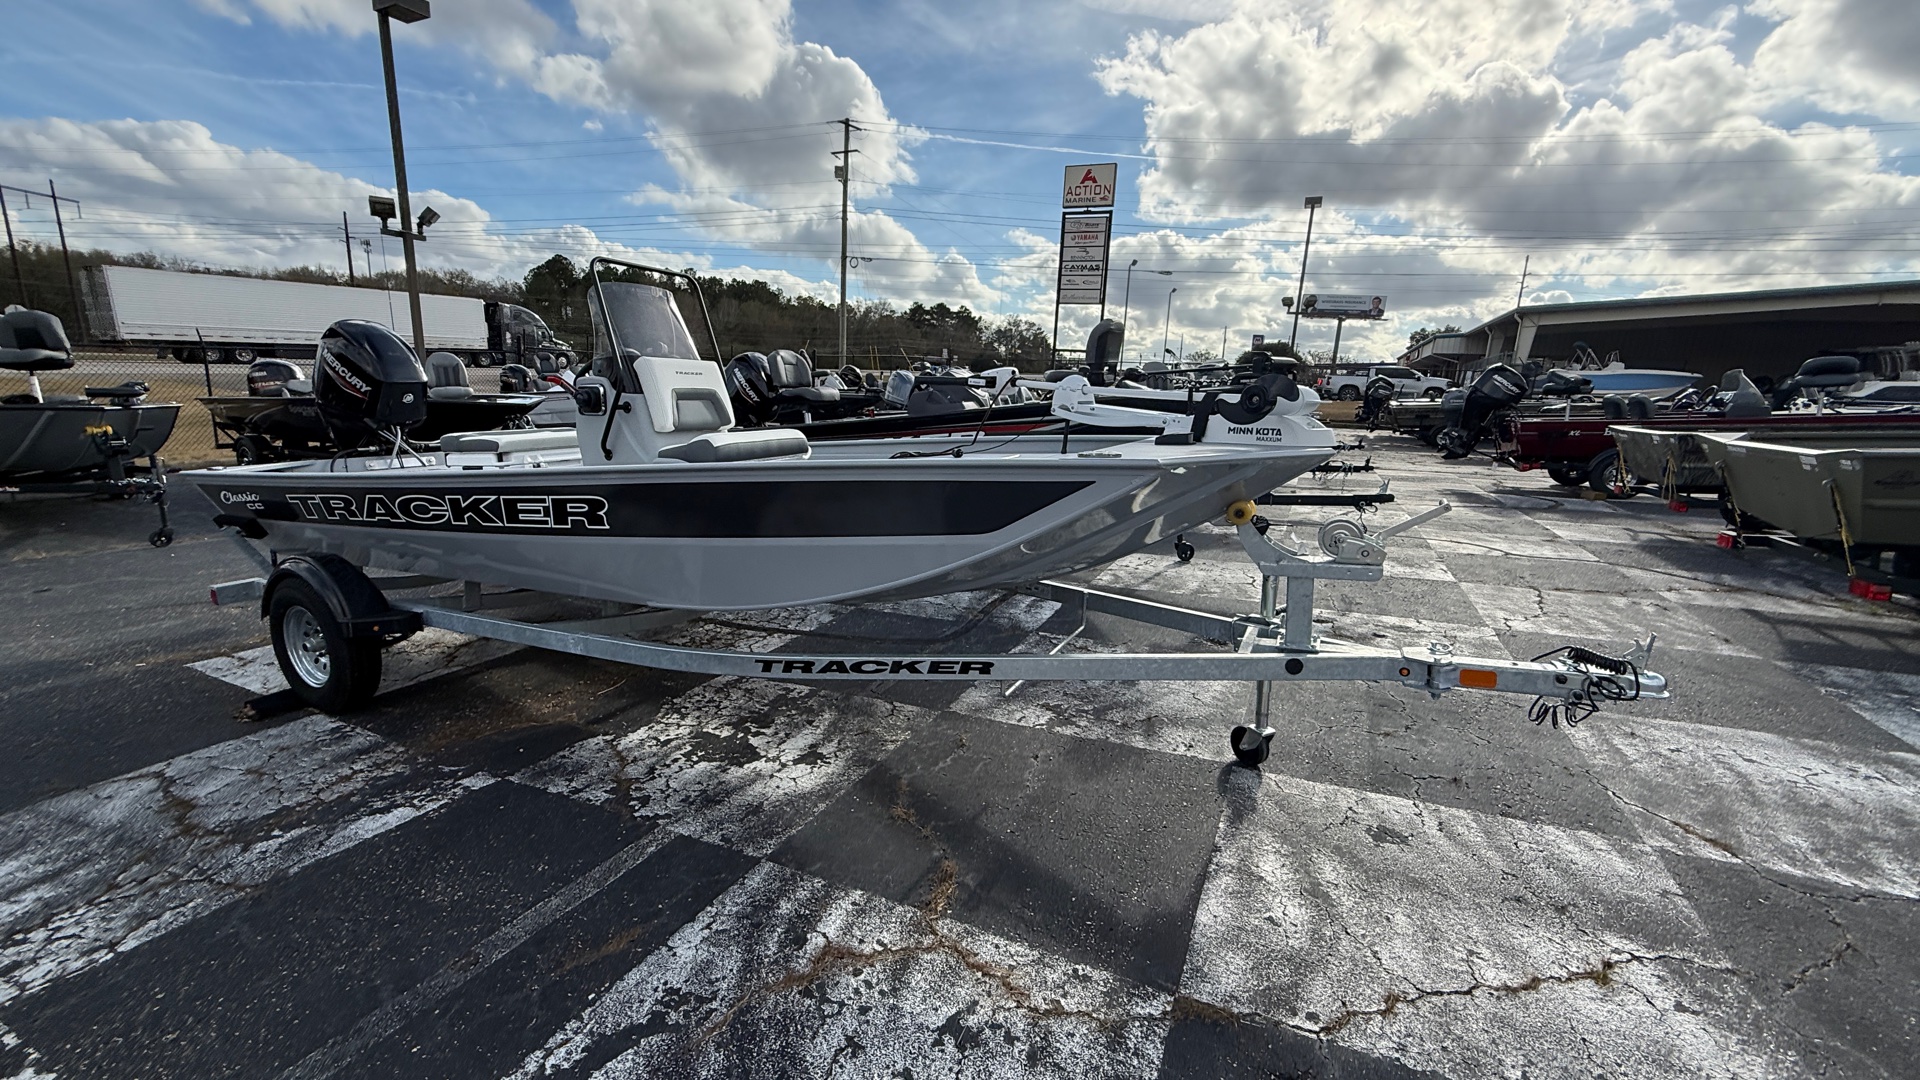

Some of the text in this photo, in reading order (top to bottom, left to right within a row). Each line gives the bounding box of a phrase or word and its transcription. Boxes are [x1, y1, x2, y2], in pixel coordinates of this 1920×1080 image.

[1066, 184, 1111, 197] ACTION
[322, 348, 372, 393] MERCURY
[733, 367, 760, 402] MERCURY
[1492, 374, 1521, 393] MERCURY
[1227, 426, 1282, 436] MINN KOTA
[220, 491, 260, 504] Classic
[285, 494, 610, 529] TRACKER
[754, 659, 995, 675] TRACKER
